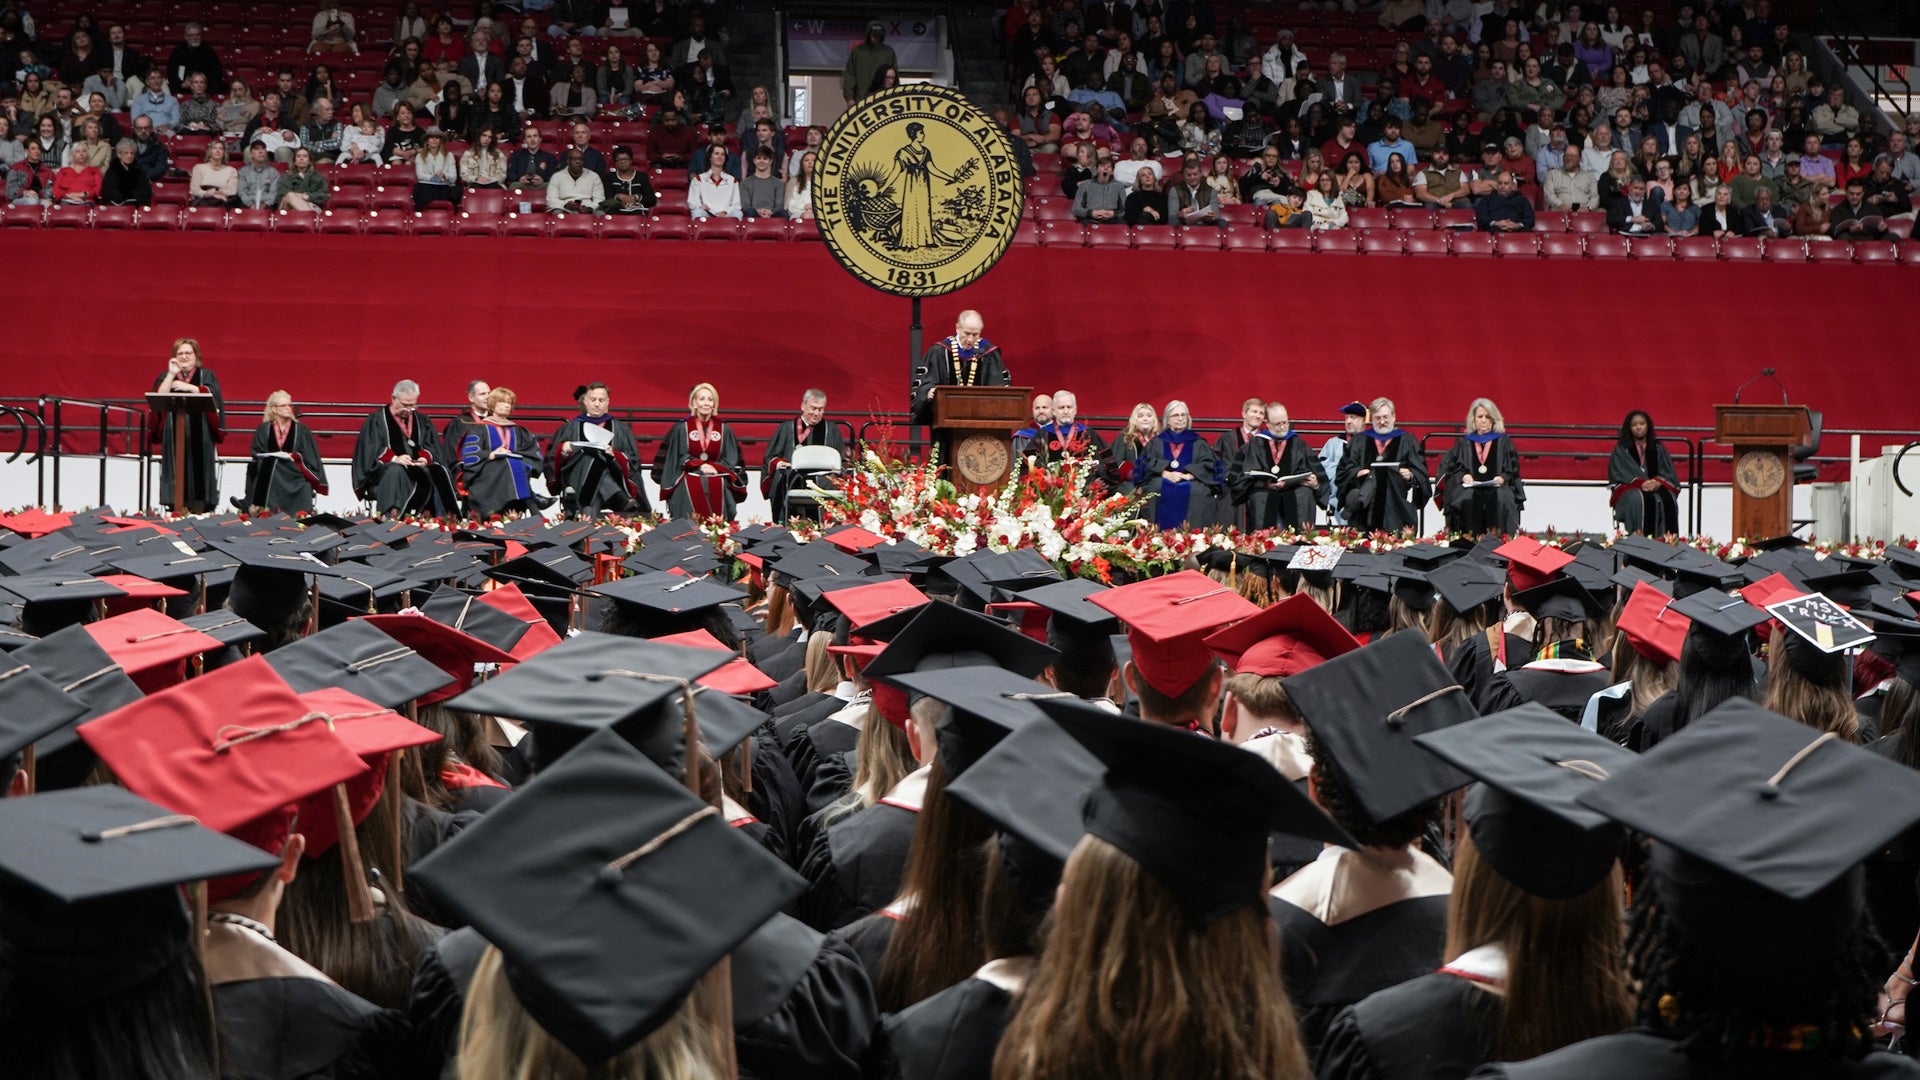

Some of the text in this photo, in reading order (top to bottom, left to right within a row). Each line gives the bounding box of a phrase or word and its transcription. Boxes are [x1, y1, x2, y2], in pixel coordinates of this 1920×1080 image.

[807, 19, 825, 34] W
[890, 21, 901, 36] X
[824, 97, 1013, 239] THE UNIVERSITY OF ALABAMA
[887, 268, 937, 286] 1831
[1805, 600, 1838, 615] MS.
